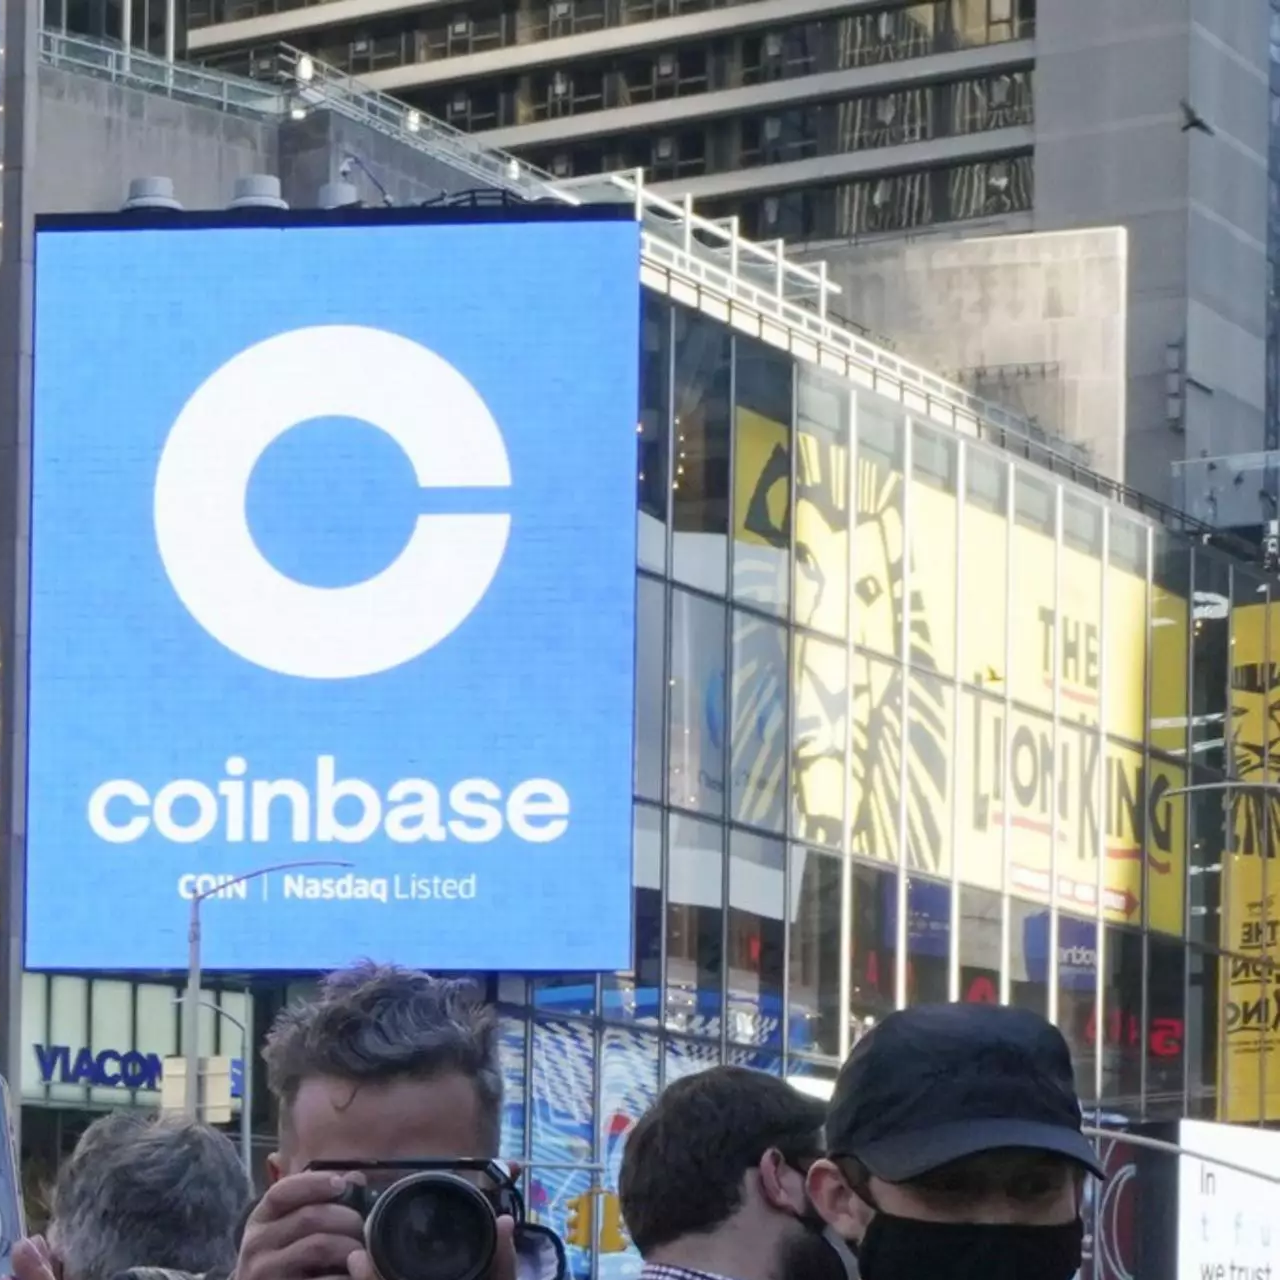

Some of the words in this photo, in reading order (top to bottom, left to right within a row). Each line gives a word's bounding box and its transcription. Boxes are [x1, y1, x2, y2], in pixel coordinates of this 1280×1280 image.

[1038, 605, 1098, 690] THE
[87, 755, 571, 843] coinbase
[177, 873, 247, 900] COIN
[283, 872, 388, 903] Nasdaq
[393, 872, 477, 900] Listed
[1200, 1161, 1216, 1196] In
